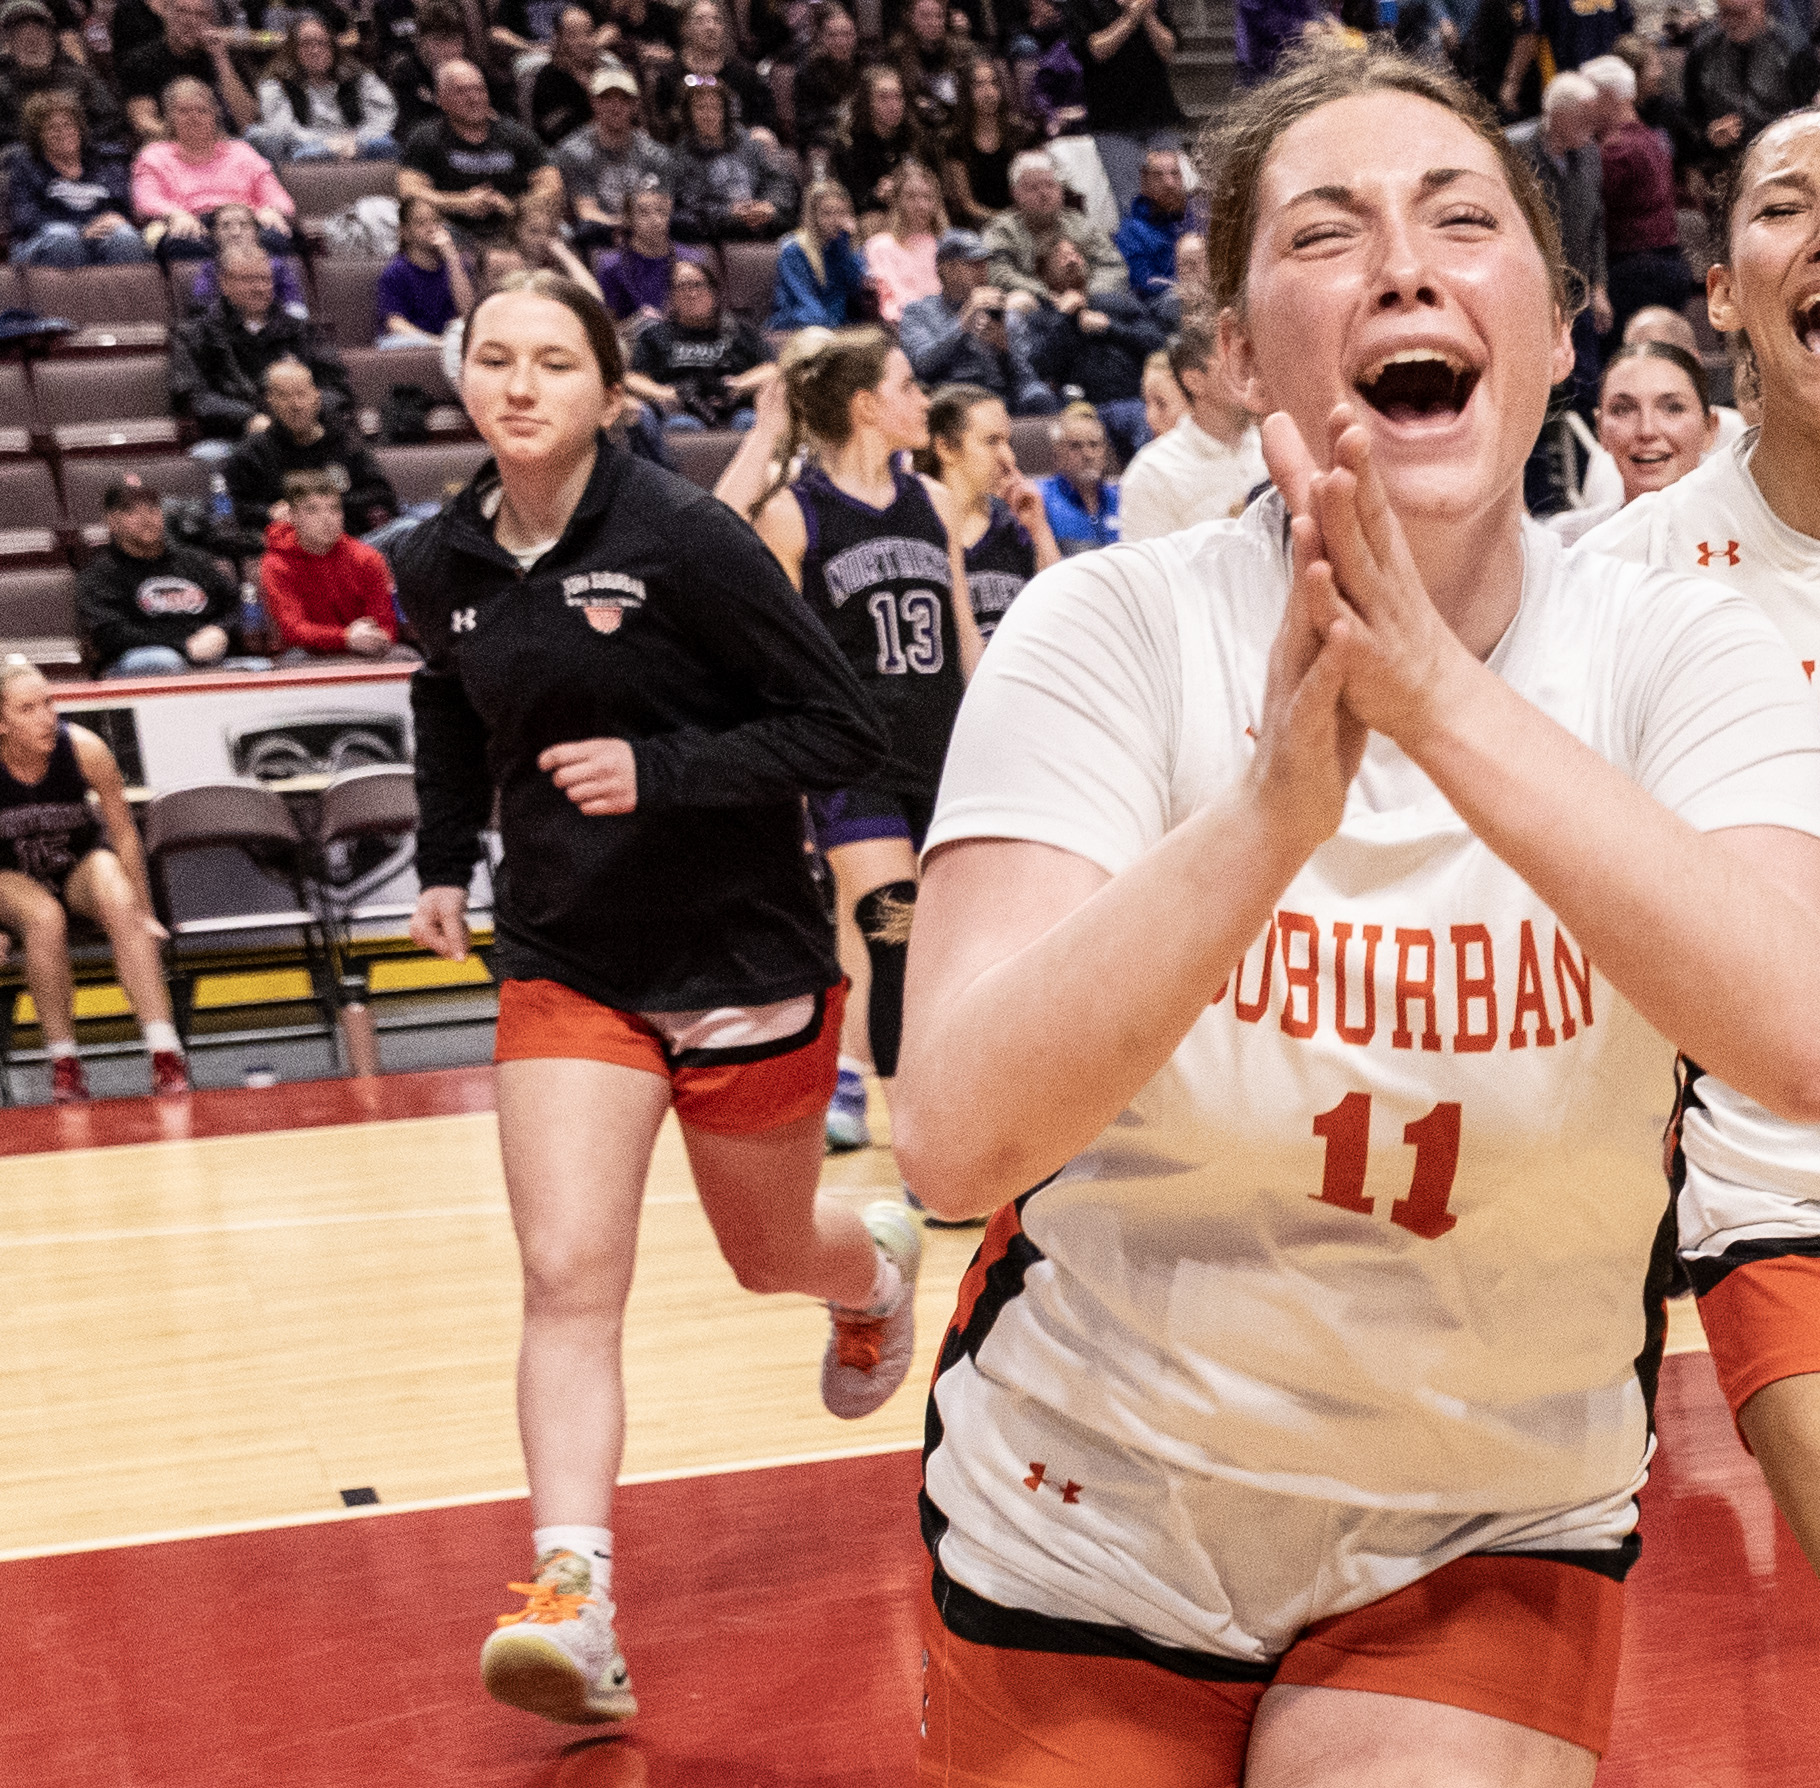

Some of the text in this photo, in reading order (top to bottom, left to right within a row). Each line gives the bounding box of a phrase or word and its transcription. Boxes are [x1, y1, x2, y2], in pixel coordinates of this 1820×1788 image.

[867, 588, 944, 675] 13
[1212, 910, 1595, 1054] UBURBAN
[1308, 1091, 1462, 1241] 11
